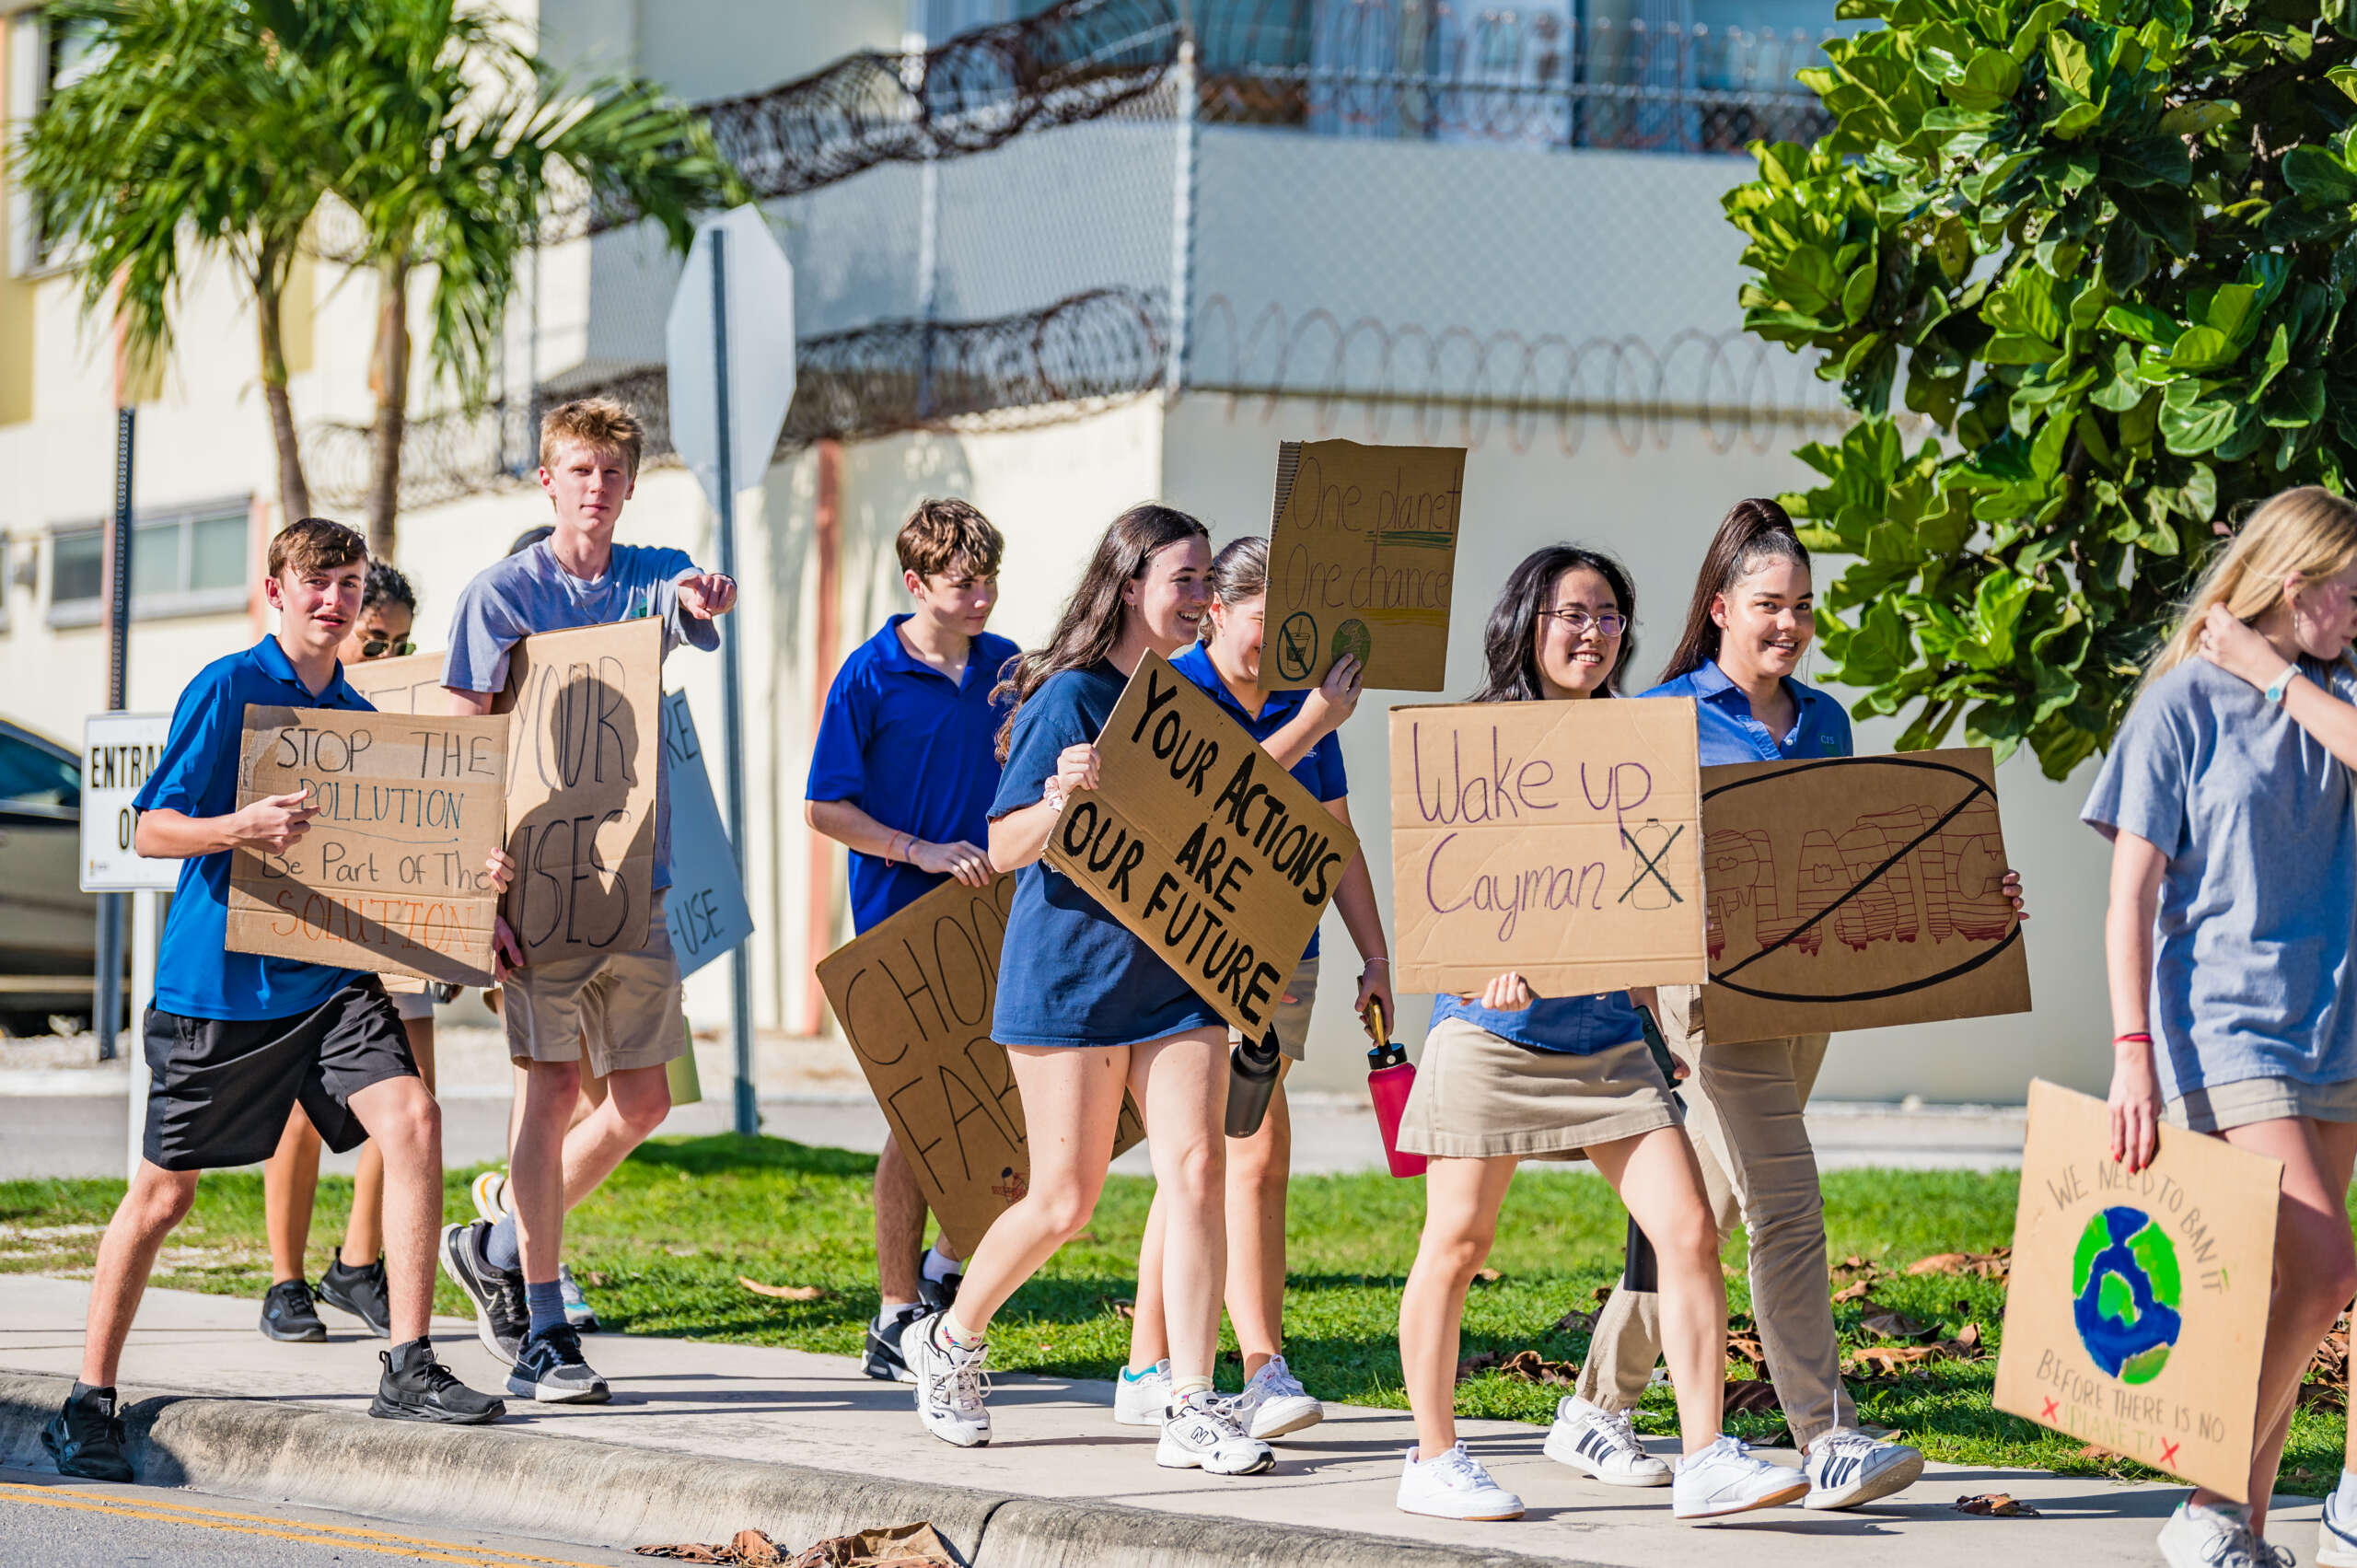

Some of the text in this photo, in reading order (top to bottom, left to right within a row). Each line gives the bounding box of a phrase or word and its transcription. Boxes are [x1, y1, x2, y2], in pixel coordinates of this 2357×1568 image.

[1293, 456, 1462, 543] One planet
[1285, 542, 1451, 611] One chance
[276, 727, 495, 779] STOP THE
[1130, 668, 1342, 907] YOUR ACTIONS
[1412, 721, 1653, 851] Wake up
[299, 778, 465, 830] POLLUTION
[261, 849, 304, 879] Be
[321, 842, 380, 883] Part
[433, 850, 492, 891] The
[1174, 821, 1254, 914] ARE
[1426, 832, 1606, 943] Cayman
[272, 889, 475, 954] SOLUTION
[1062, 800, 1282, 1027] OUR FUTURE
[2046, 1163, 2089, 1212] WE
[2098, 1159, 2155, 1197] NEED
[2157, 1174, 2185, 1214] TO
[2179, 1206, 2218, 1264] BAN
[2036, 1348, 2225, 1444] BEFORE THERE IS NO
